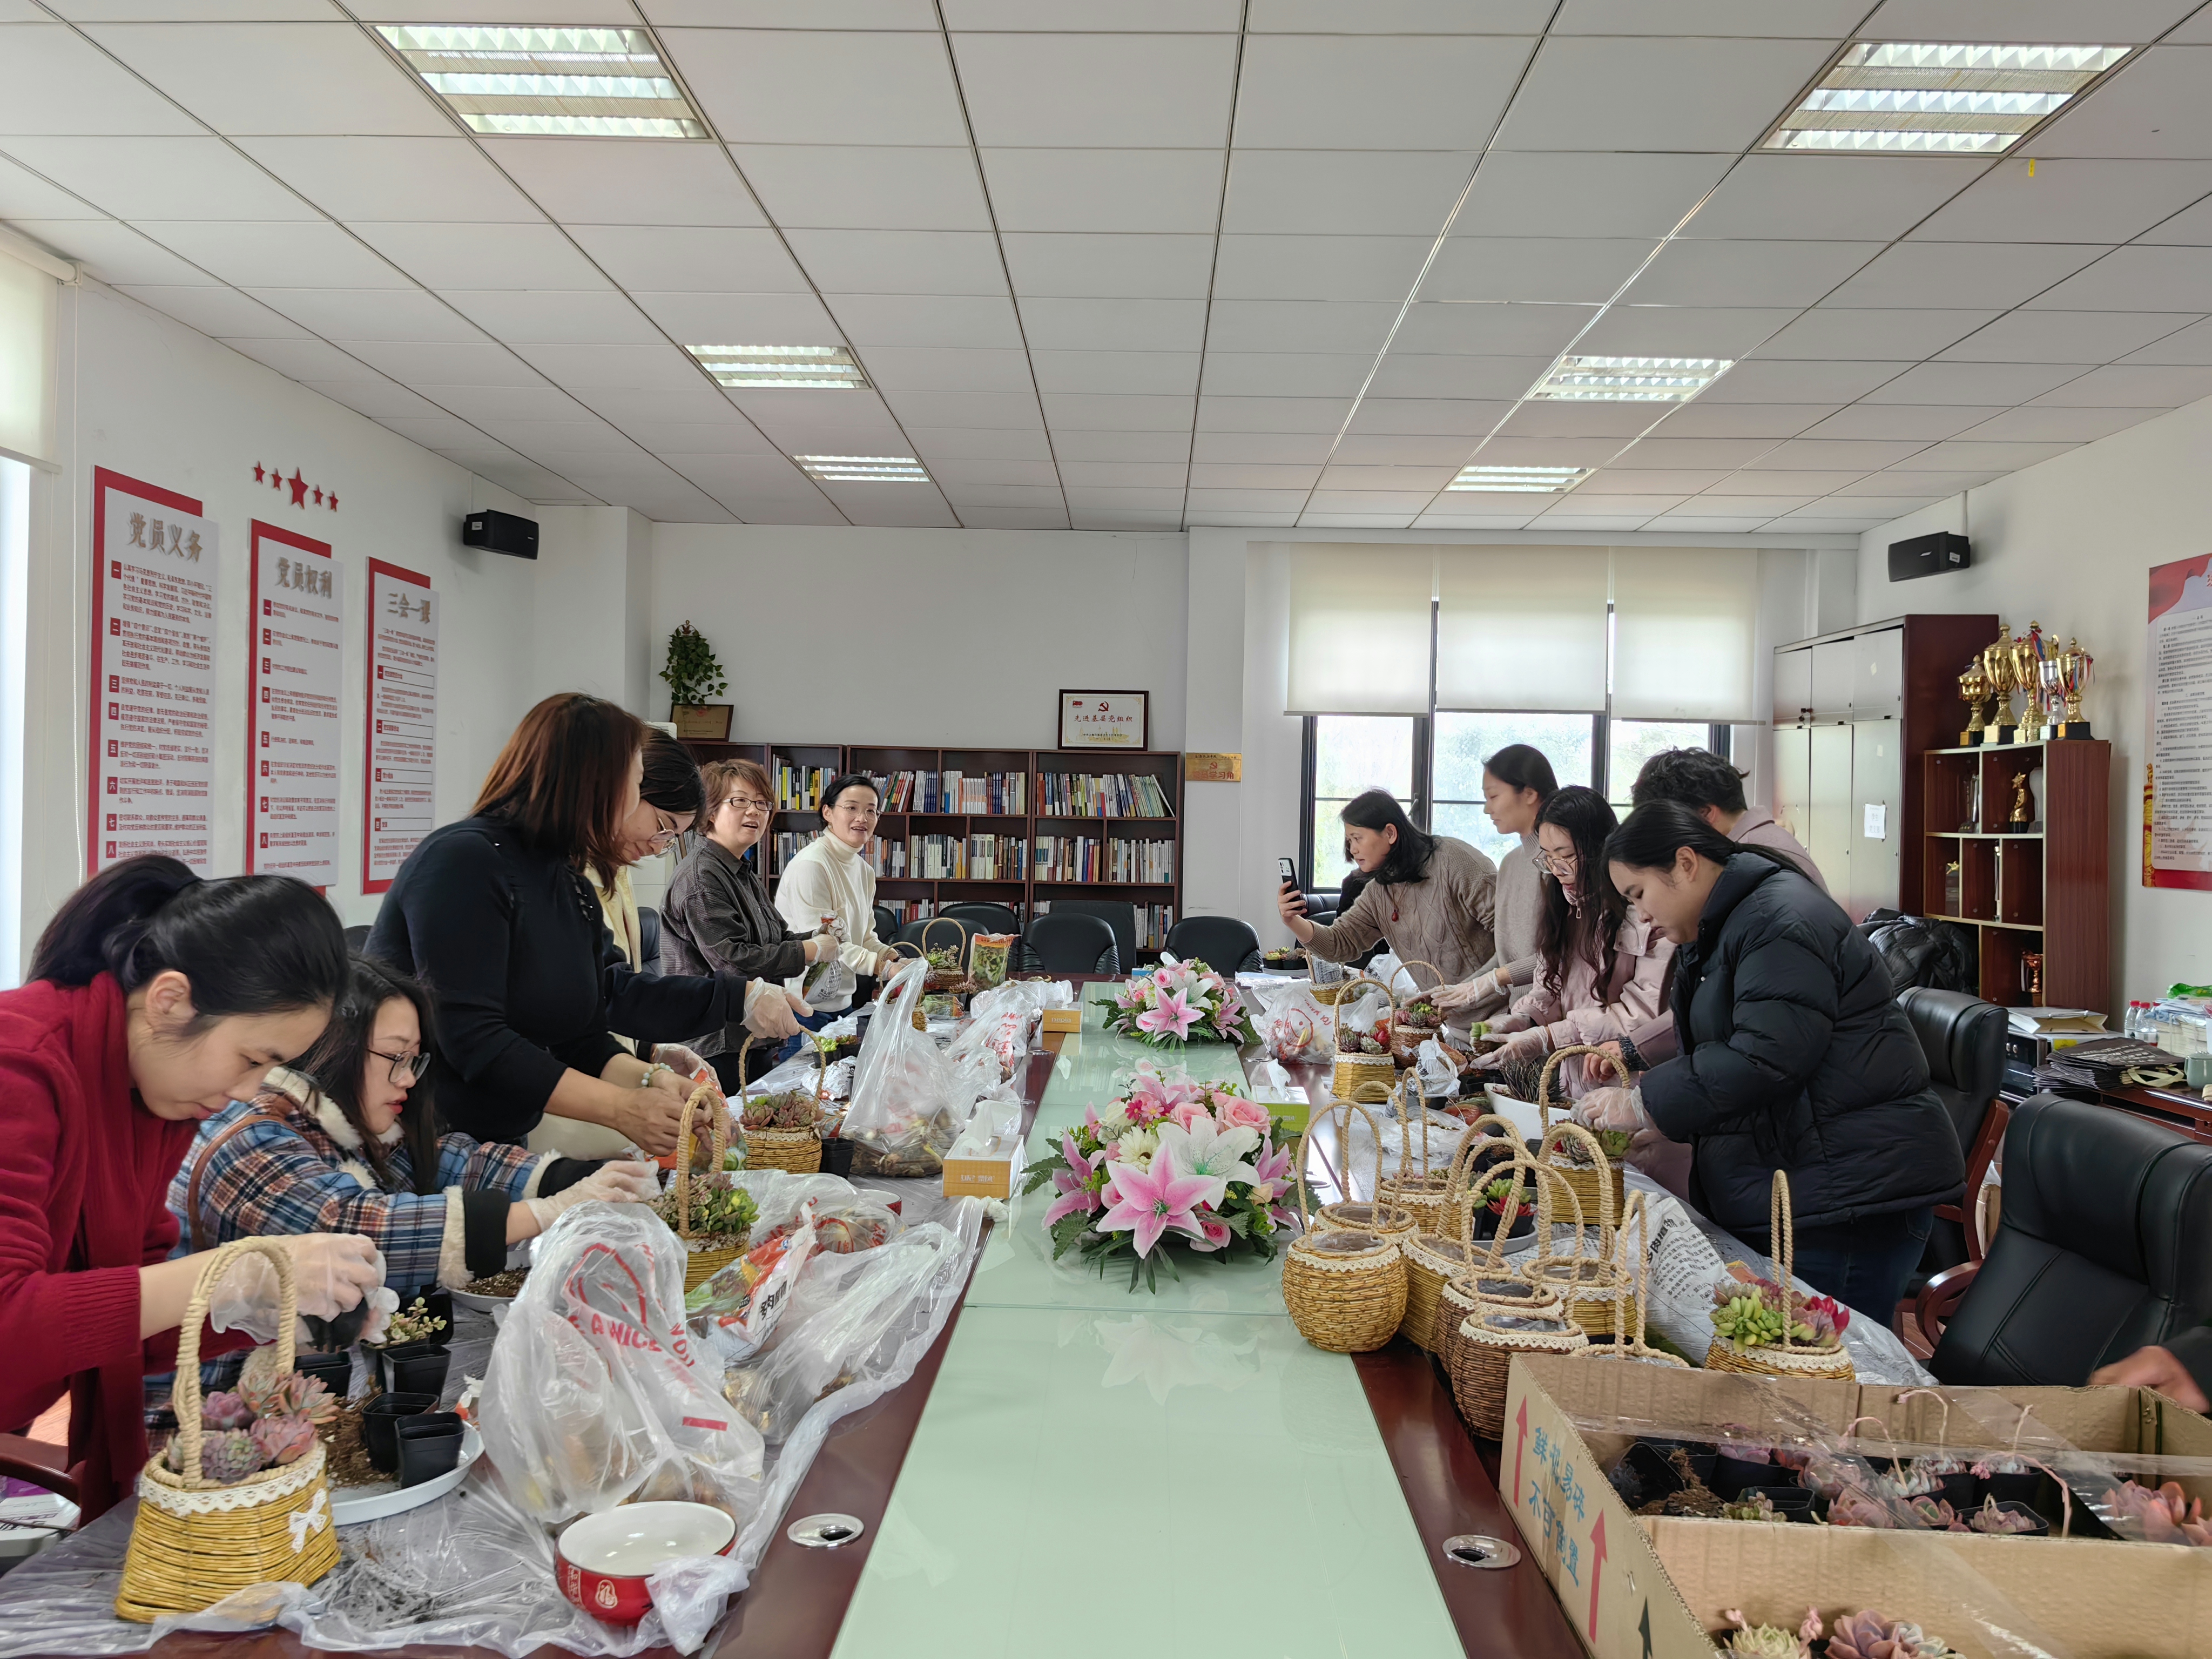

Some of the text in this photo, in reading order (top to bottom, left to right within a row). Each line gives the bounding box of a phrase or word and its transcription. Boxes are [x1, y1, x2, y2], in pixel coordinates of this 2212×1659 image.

[128, 512, 203, 562] 党员义务
[274, 556, 333, 599] 党员权利
[387, 592, 431, 624] 三会一课
[1074, 714, 1133, 723] 先进基层党组织
[1529, 1480, 1579, 1588] 不可倒置
